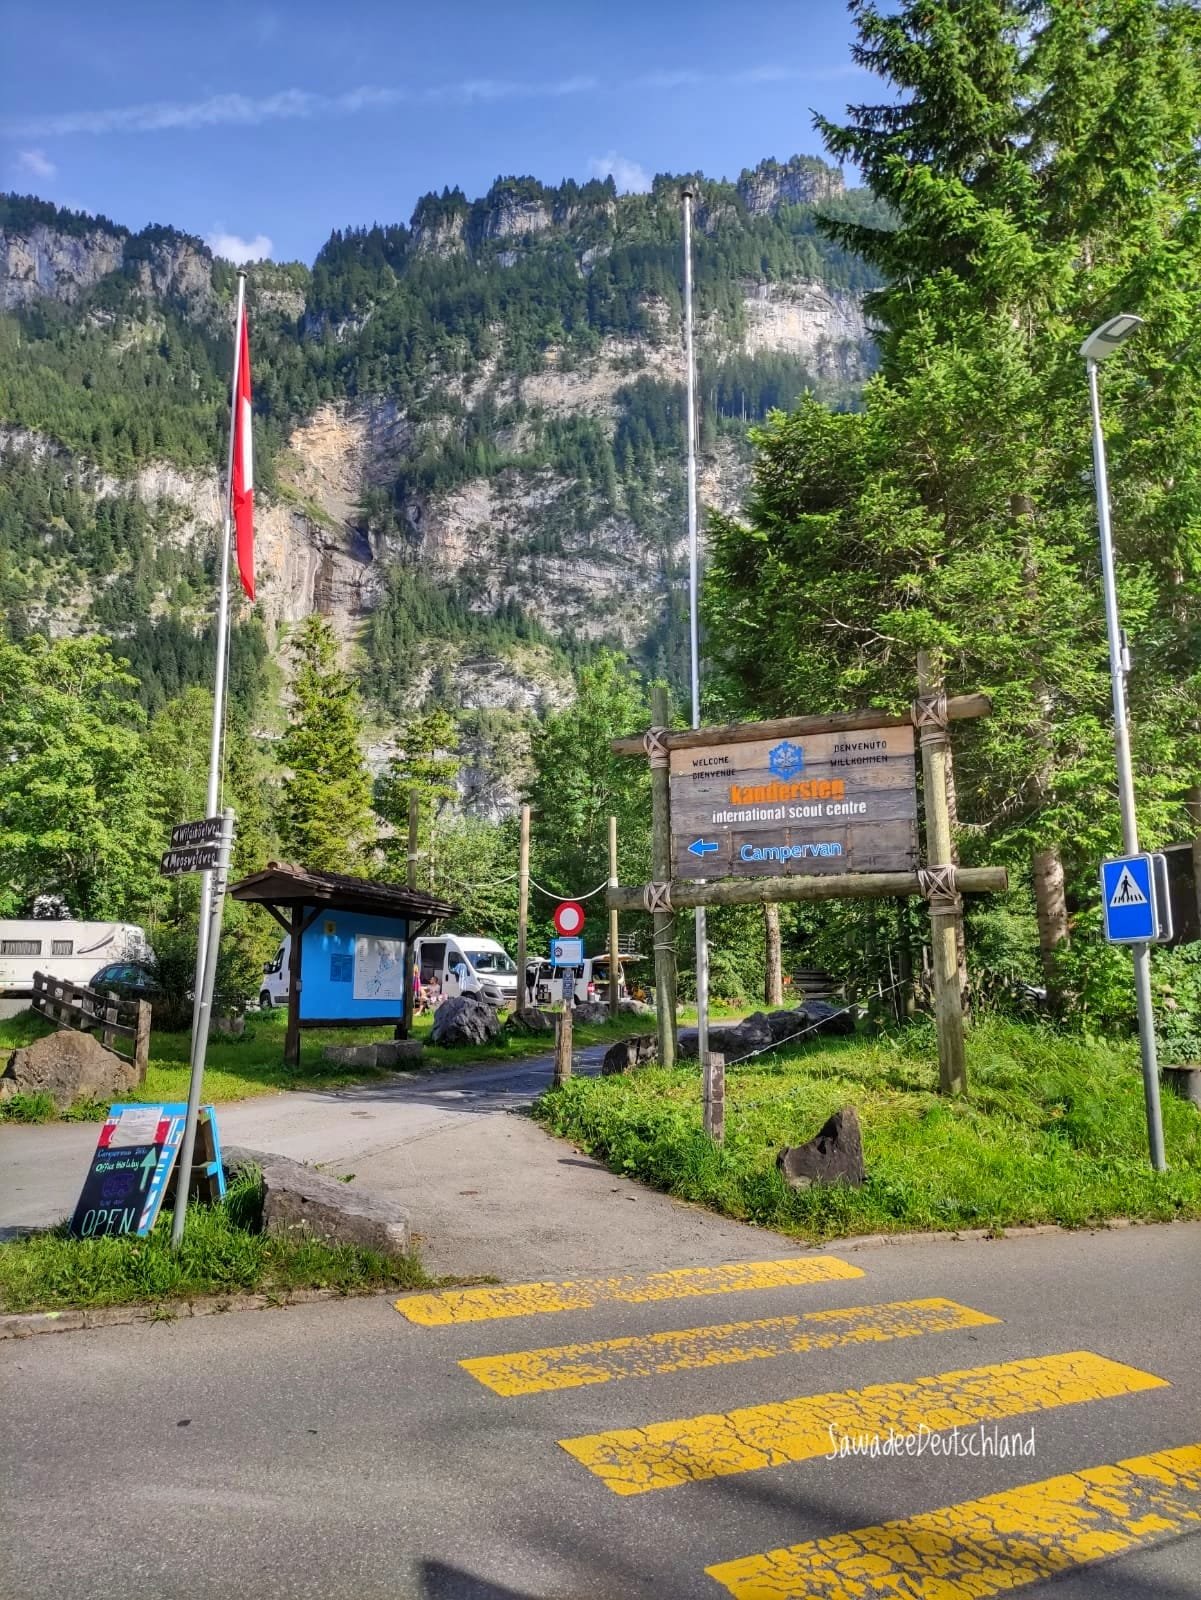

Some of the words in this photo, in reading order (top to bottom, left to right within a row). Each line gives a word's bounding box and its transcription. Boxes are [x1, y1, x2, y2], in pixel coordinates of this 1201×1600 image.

[692, 756, 729, 767] WELCOME
[830, 754, 888, 767] WILLKOMMEN
[729, 778, 845, 806] kandersteg
[712, 805, 785, 824] international
[788, 803, 822, 819] scout
[826, 801, 867, 816] centre
[740, 840, 842, 864] Campervan
[81, 1207, 136, 1236] OPEN
